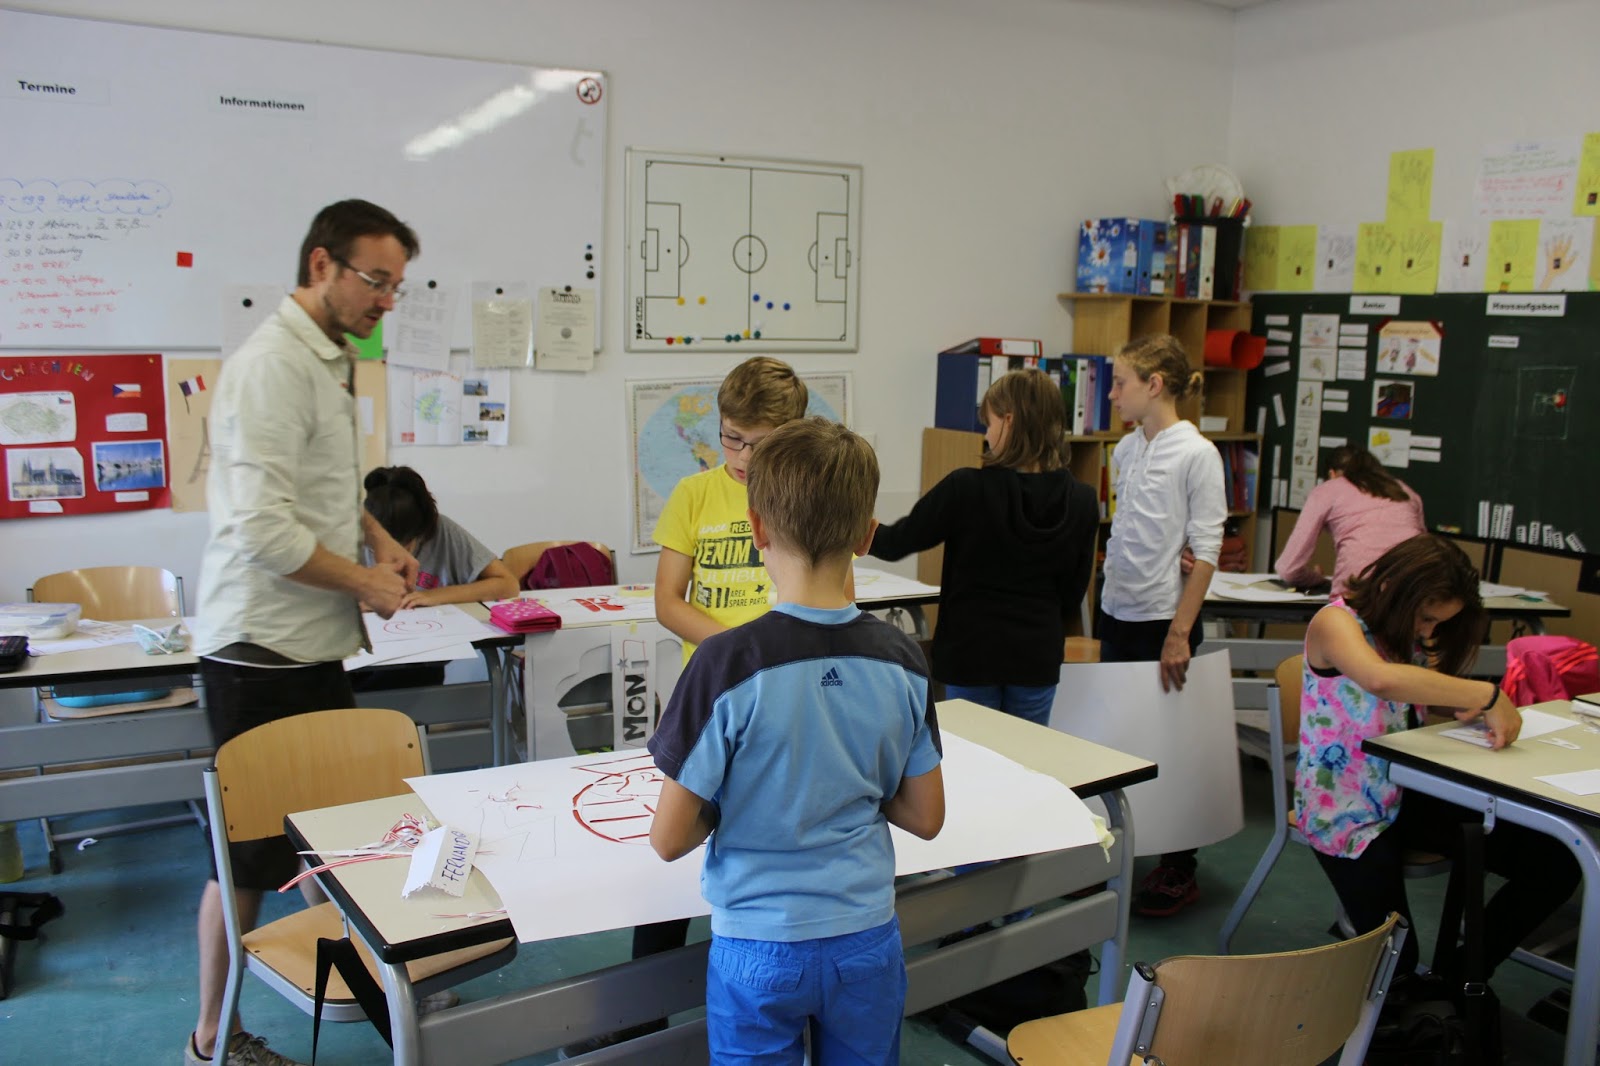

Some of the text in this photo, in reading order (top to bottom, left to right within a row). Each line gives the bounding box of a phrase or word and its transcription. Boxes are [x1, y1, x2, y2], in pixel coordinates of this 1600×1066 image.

[18, 80, 77, 95] Termine
[219, 96, 305, 112] Informationen
[1492, 302, 1560, 312] Hausaufgaben
[729, 599, 748, 607] SPARE
[820, 679, 843, 687] adidas
[441, 830, 471, 882] FERNANDO
